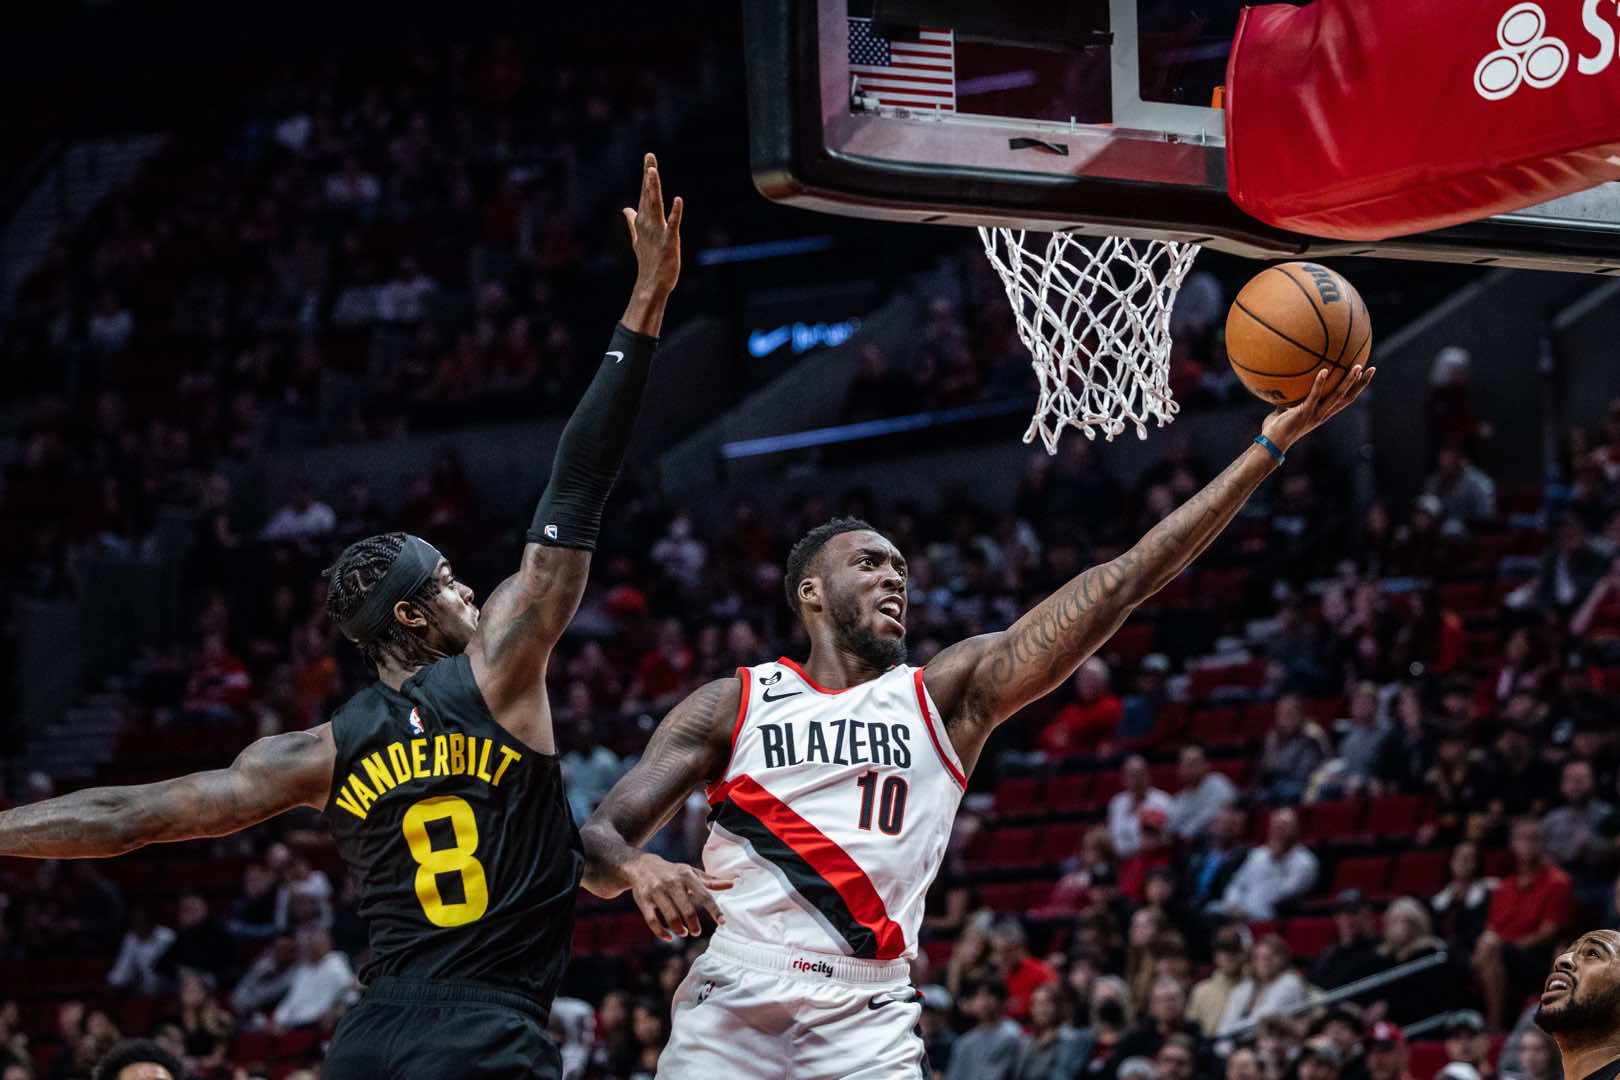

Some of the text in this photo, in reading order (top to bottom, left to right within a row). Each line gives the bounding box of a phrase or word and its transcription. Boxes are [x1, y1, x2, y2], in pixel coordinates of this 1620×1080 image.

[1577, 0, 1620, 76] S
[335, 732, 522, 821] VANDERBILT
[757, 718, 912, 769] BLAZERS
[856, 769, 910, 837] 10
[402, 795, 489, 928] 8
